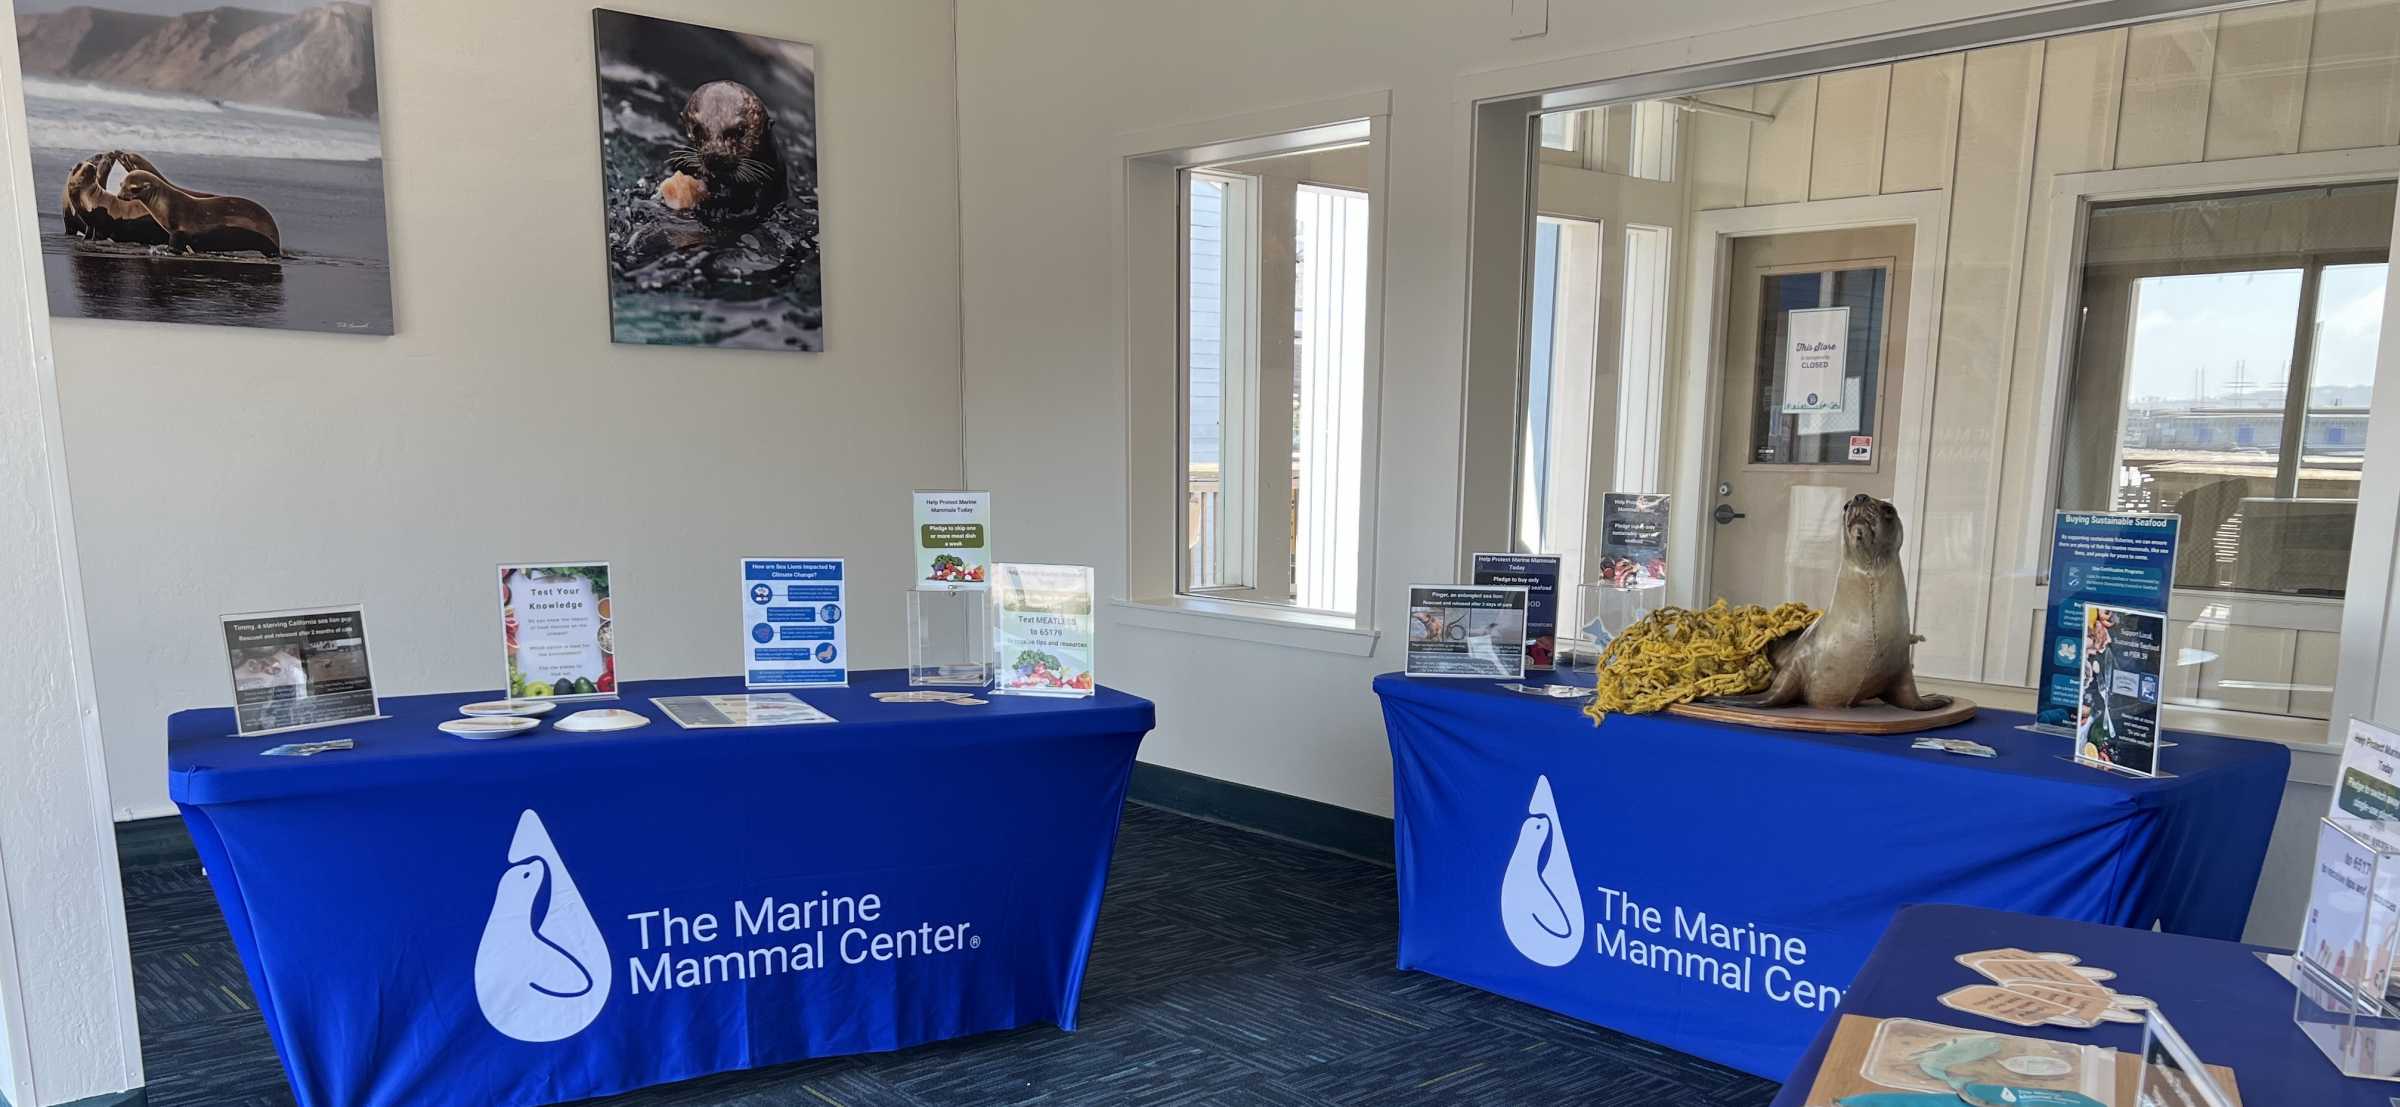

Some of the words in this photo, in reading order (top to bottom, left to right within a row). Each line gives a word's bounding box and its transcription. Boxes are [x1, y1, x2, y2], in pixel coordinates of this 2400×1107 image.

[1796, 342, 1812, 352] This
[1814, 342, 1836, 352] Store
[2066, 515, 2089, 525] Buying
[2091, 516, 2133, 526] Sustainable
[2135, 519, 2166, 527] Seafood
[529, 601, 583, 610] Knowledge
[1036, 617, 1076, 625] MEATLESS
[2120, 628, 2138, 637] Support
[2114, 637, 2139, 648] Sustainable
[2140, 642, 2160, 651] Seafood
[2379, 760, 2394, 777] Today
[2348, 776, 2364, 792] Pledge
[2345, 852, 2352, 866] to
[2353, 857, 2372, 875] 6517
[628, 908, 718, 950] The
[734, 890, 881, 937] Marine
[1598, 886, 1662, 933] The
[1675, 906, 1807, 965] Marine
[629, 931, 824, 994] Mammal
[1596, 923, 1751, 992] Mammal
[1765, 966, 1843, 1012] Cen
